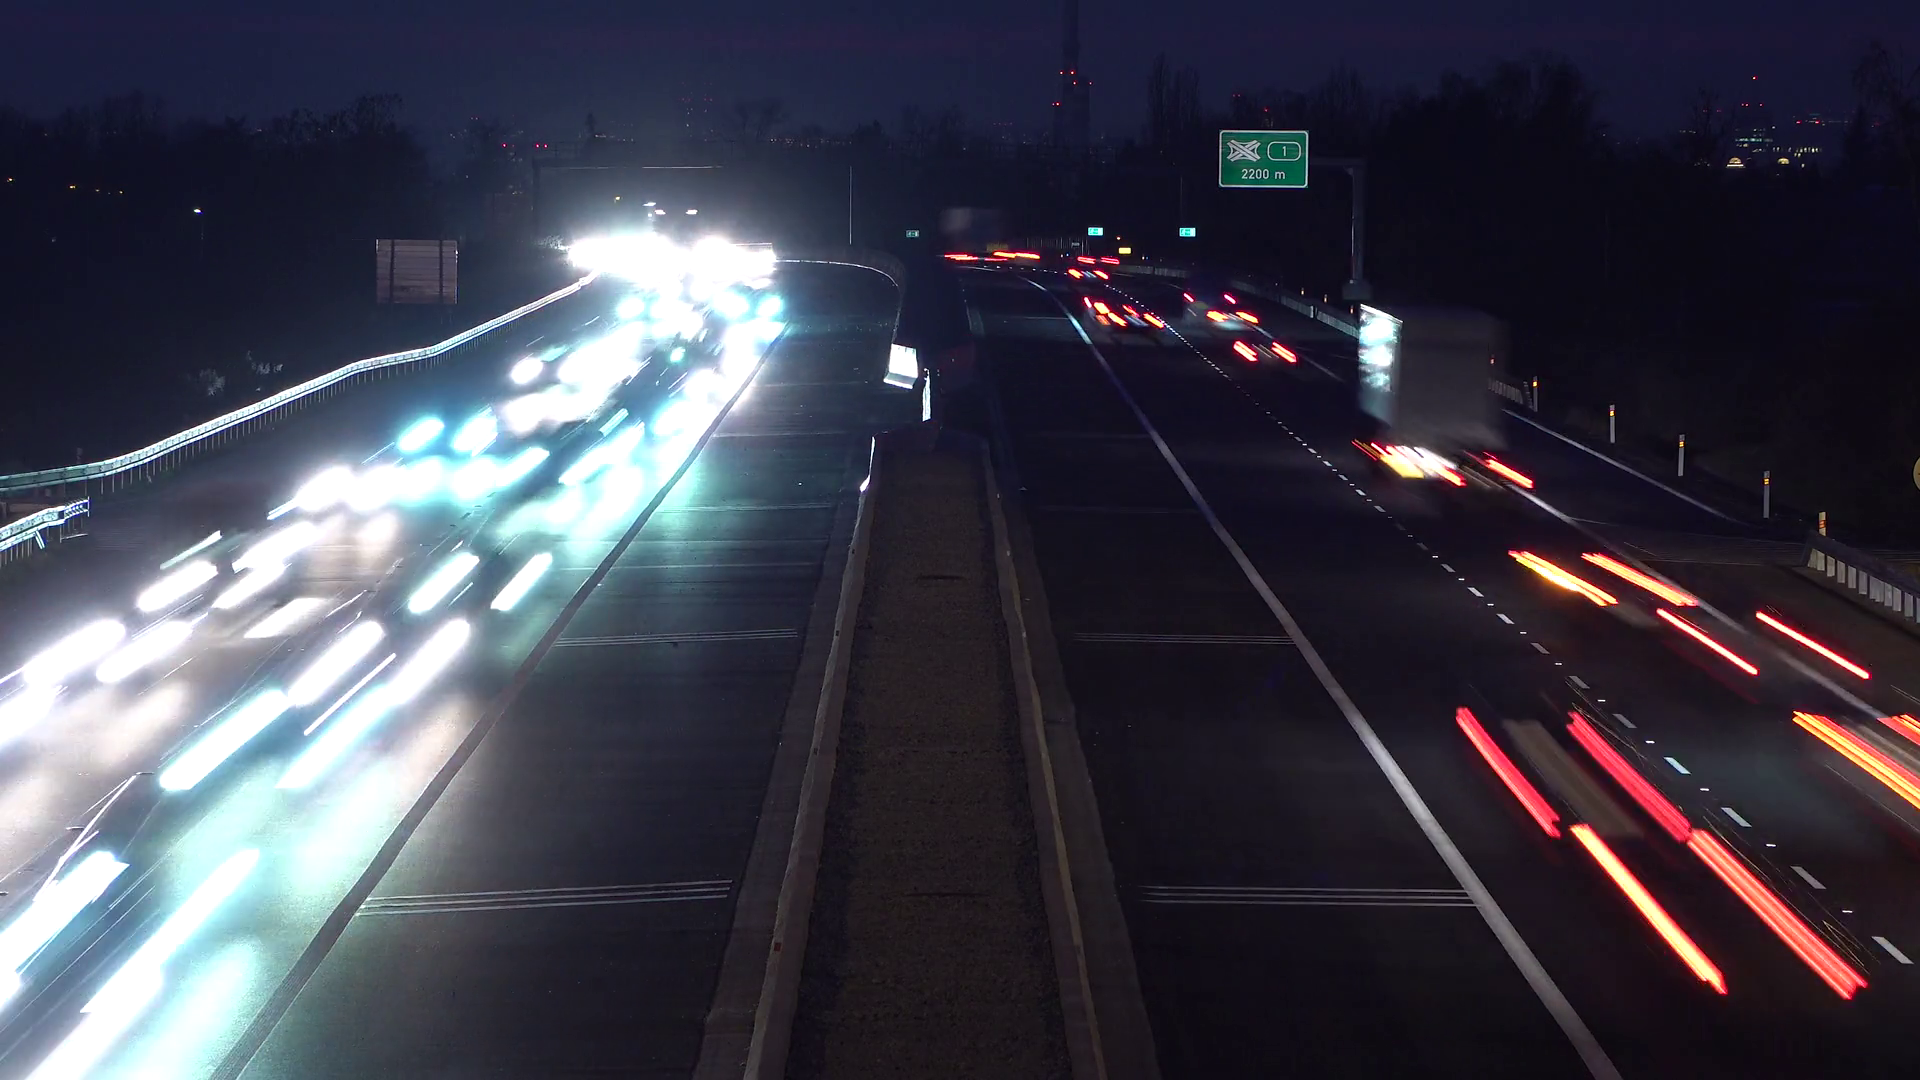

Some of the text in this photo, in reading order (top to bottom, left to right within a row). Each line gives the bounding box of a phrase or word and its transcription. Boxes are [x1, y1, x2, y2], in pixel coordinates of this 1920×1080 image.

[1282, 145, 1287, 157] 1
[1241, 168, 1286, 180] 2200 m
